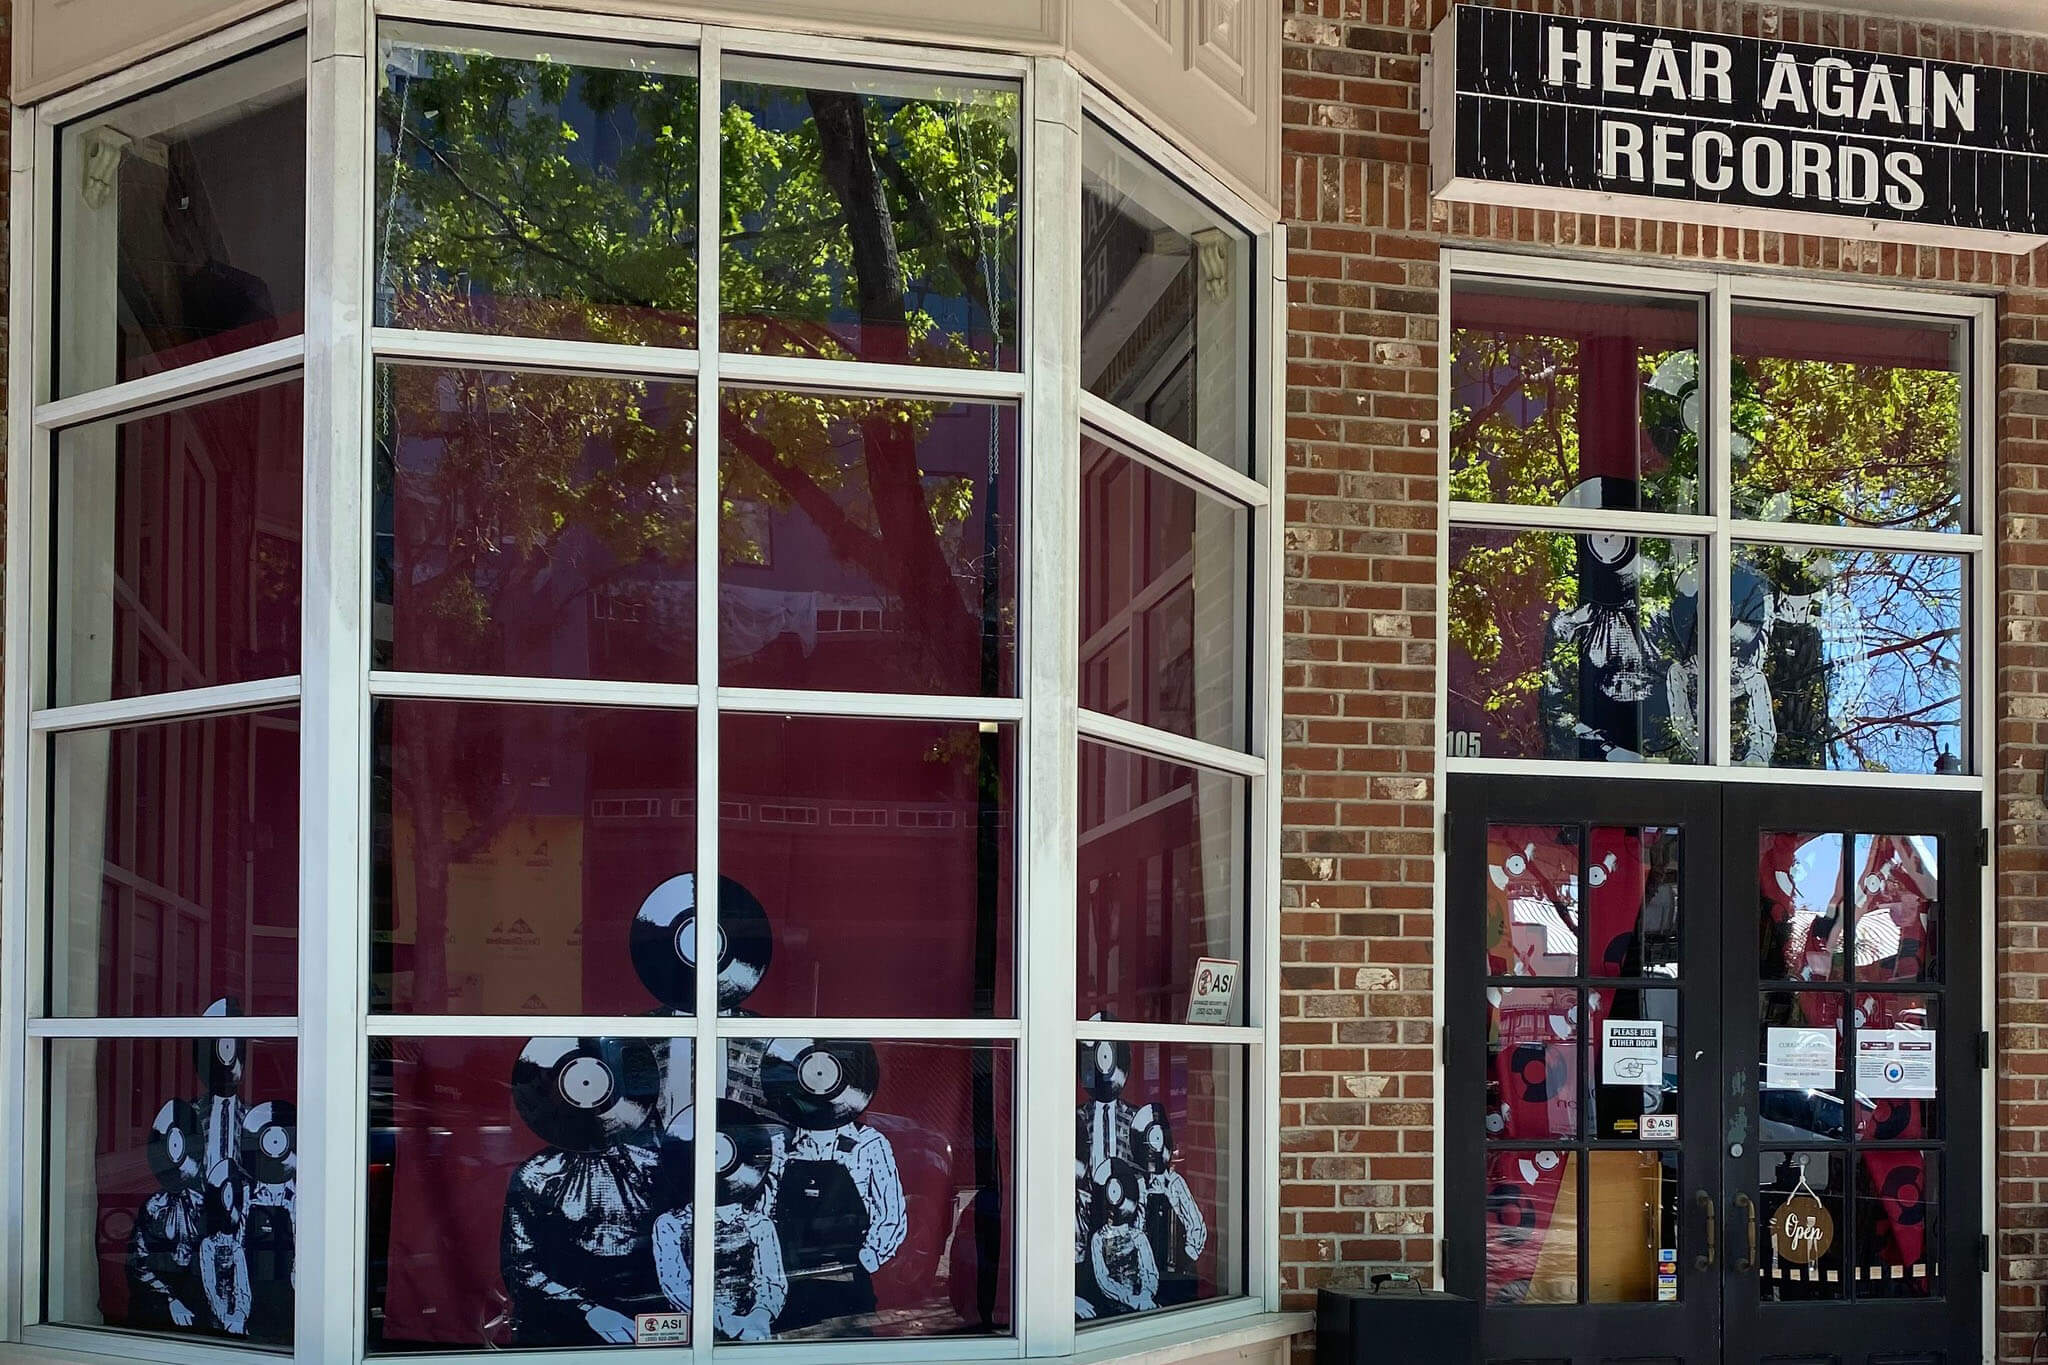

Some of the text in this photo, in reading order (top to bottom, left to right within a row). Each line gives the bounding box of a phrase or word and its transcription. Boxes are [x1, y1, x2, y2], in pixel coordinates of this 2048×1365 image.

[1548, 26, 1975, 132] HEAR AGAIN
[1602, 120, 1925, 212] RECORDS
[1447, 731, 1481, 758] 105
[1211, 974, 1233, 993] ASI
[1611, 1039, 1656, 1047] OTHER DOOR
[1613, 1028, 1639, 1036] PLEASE
[1785, 1213, 1823, 1250] Open
[661, 1319, 682, 1329] ASI
